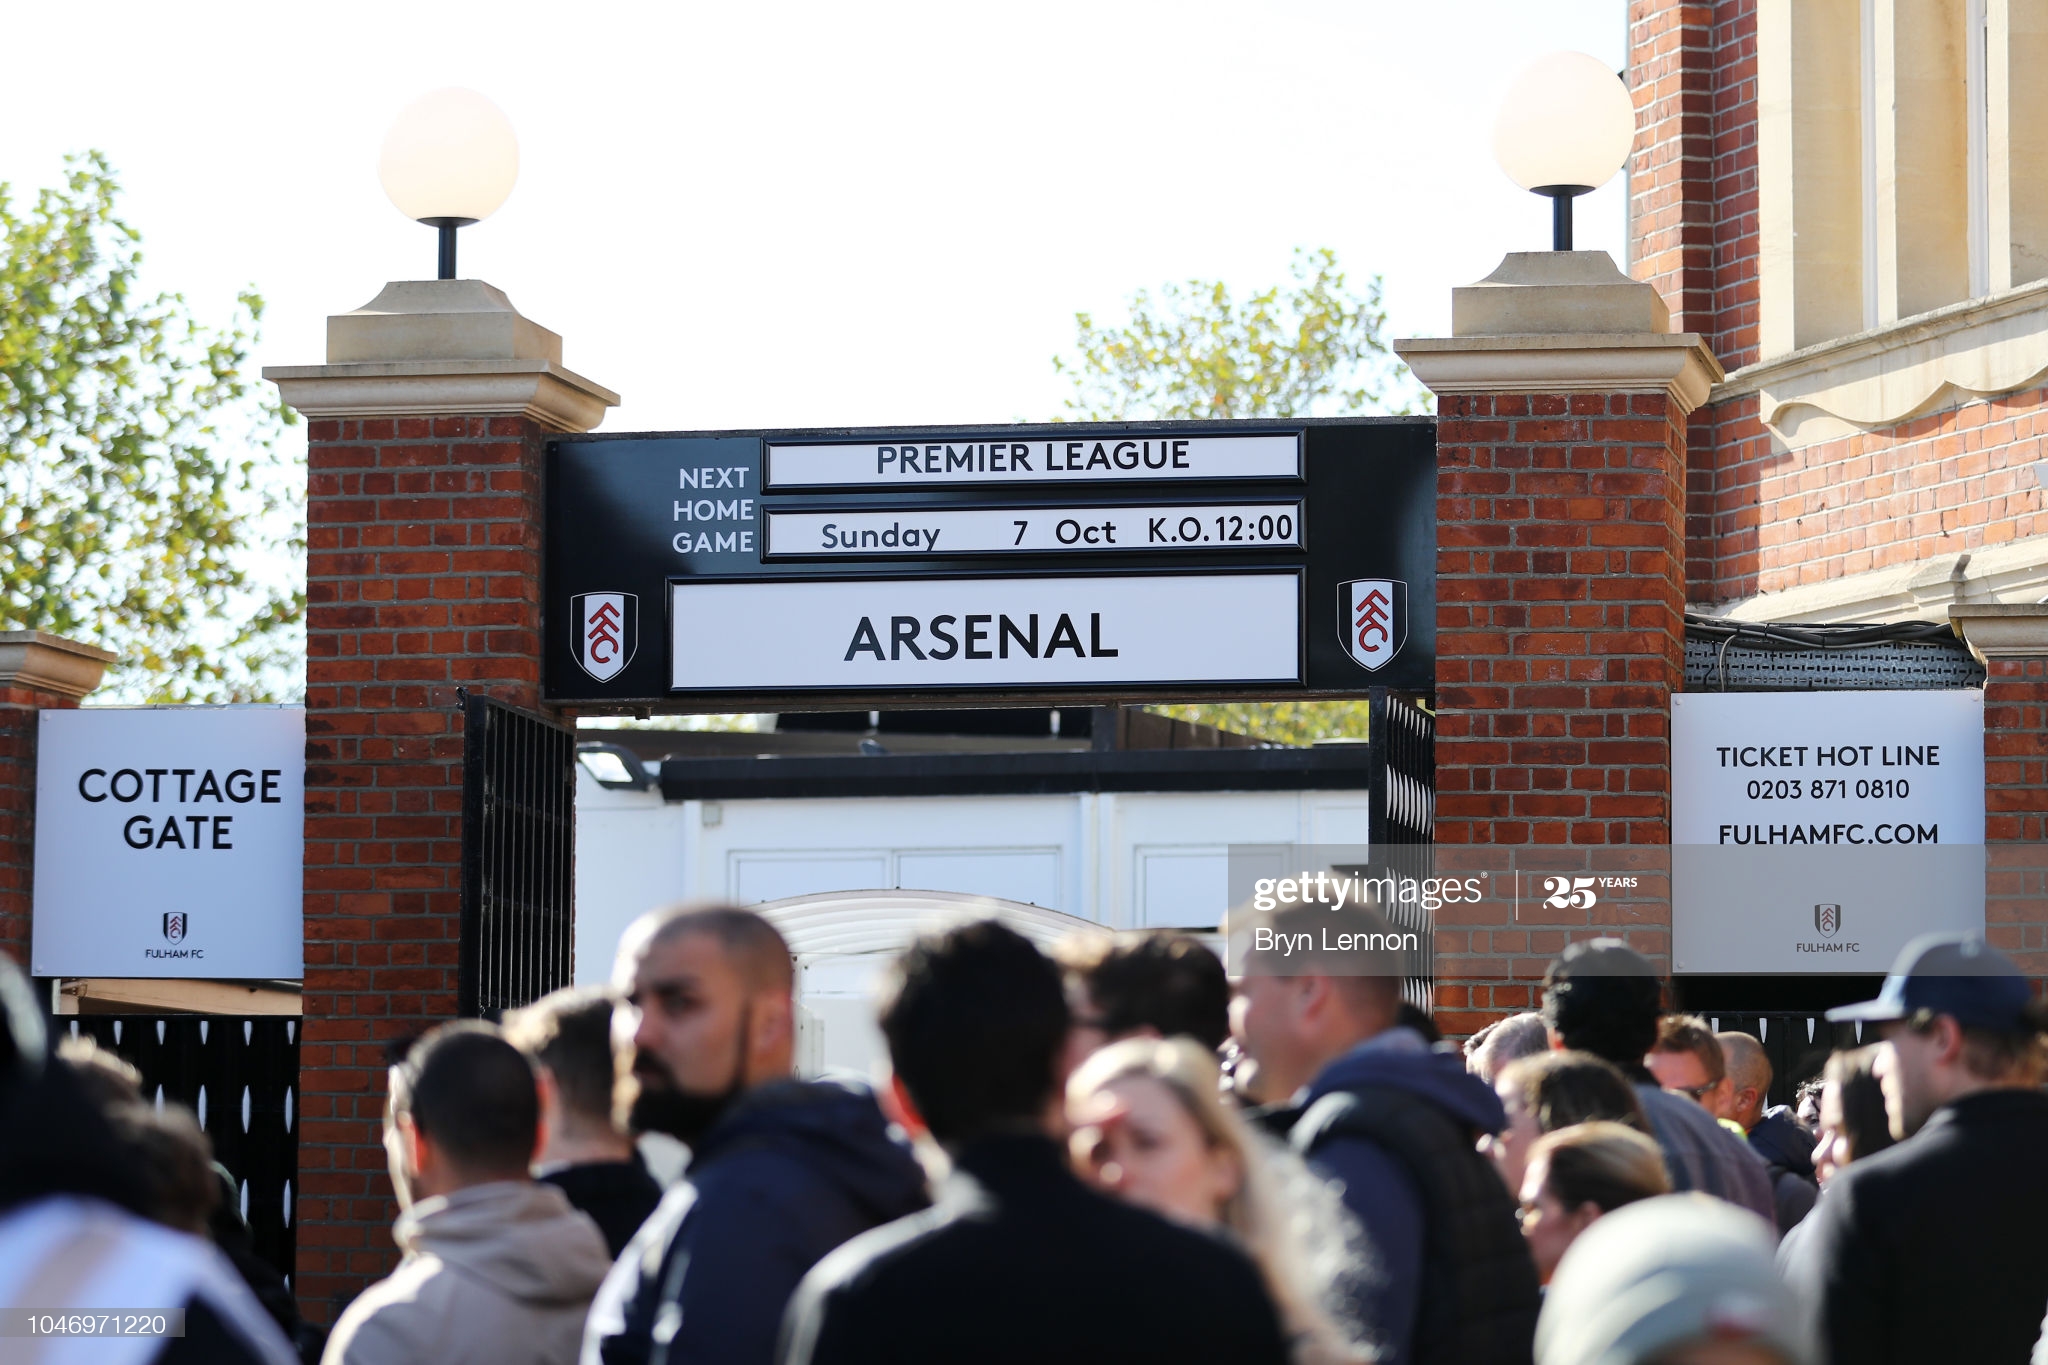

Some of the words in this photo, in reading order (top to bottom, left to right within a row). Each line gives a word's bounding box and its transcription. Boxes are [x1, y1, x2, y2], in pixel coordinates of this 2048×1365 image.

[877, 443, 1033, 473] PREMIER
[1046, 440, 1191, 470] LEAGUE
[679, 467, 749, 489] NEXT
[673, 499, 754, 521] HOME
[672, 531, 754, 553] GAME
[821, 522, 941, 552] Sunday
[1013, 521, 1027, 546] 7
[1055, 519, 1117, 545] Oct
[843, 613, 1119, 661] ARSENAL
[1717, 747, 1808, 767] TICKET
[1817, 746, 1873, 766] HOT
[1882, 746, 1940, 766] LINE
[79, 768, 281, 803] COTTAGE
[1747, 780, 1802, 799] 0203
[1811, 780, 1846, 798] 871
[1855, 779, 1910, 798] 0810
[124, 815, 233, 849] GATE
[1719, 824, 1938, 845] FULHAMFC.COM
[145, 949, 188, 958] FULHAM
[191, 949, 204, 958] FC
[1796, 943, 1843, 952] FULHAM
[1846, 943, 1860, 952] FC
